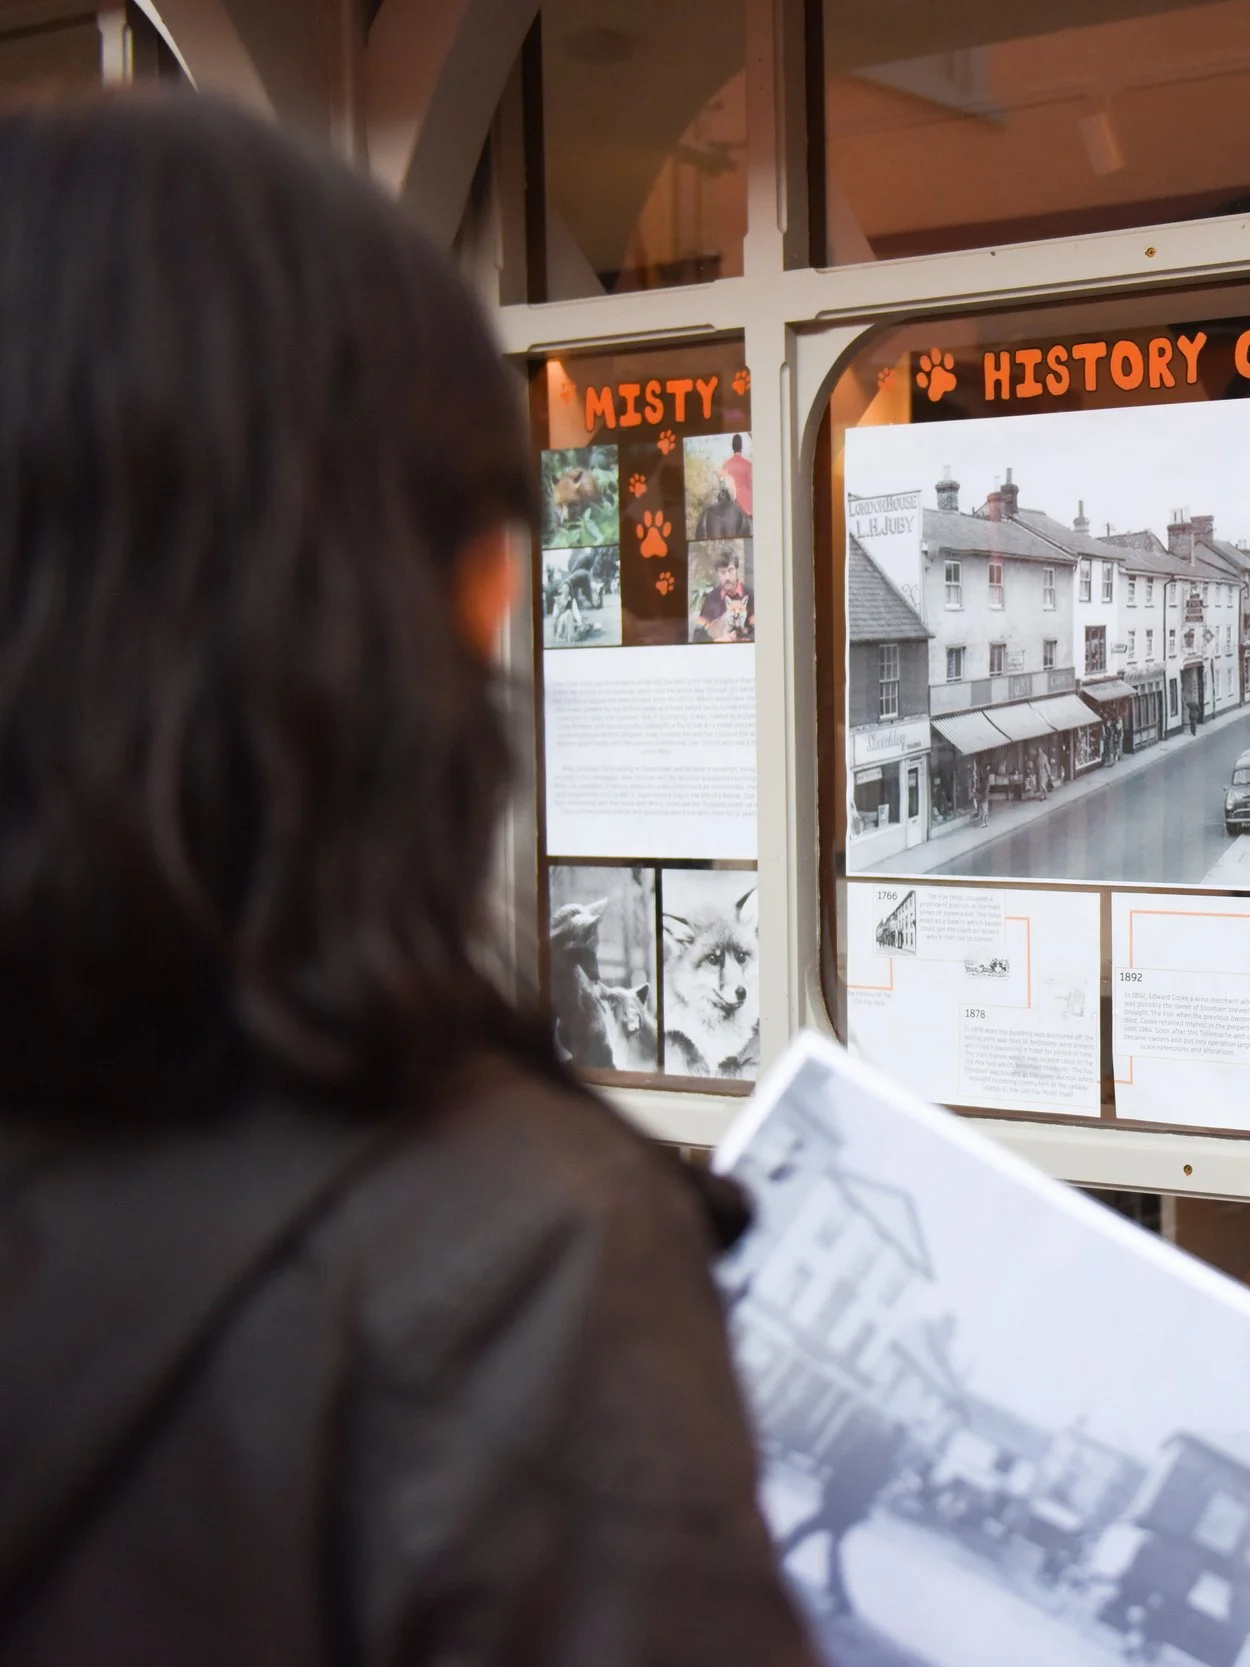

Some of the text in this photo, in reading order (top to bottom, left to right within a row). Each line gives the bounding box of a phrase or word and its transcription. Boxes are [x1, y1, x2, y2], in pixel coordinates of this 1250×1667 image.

[985, 337, 1206, 400] HISTORY
[584, 375, 719, 432] MISTY
[877, 891, 898, 901] 1766
[1120, 972, 1143, 983] 1892
[965, 1009, 986, 1019] 1878
